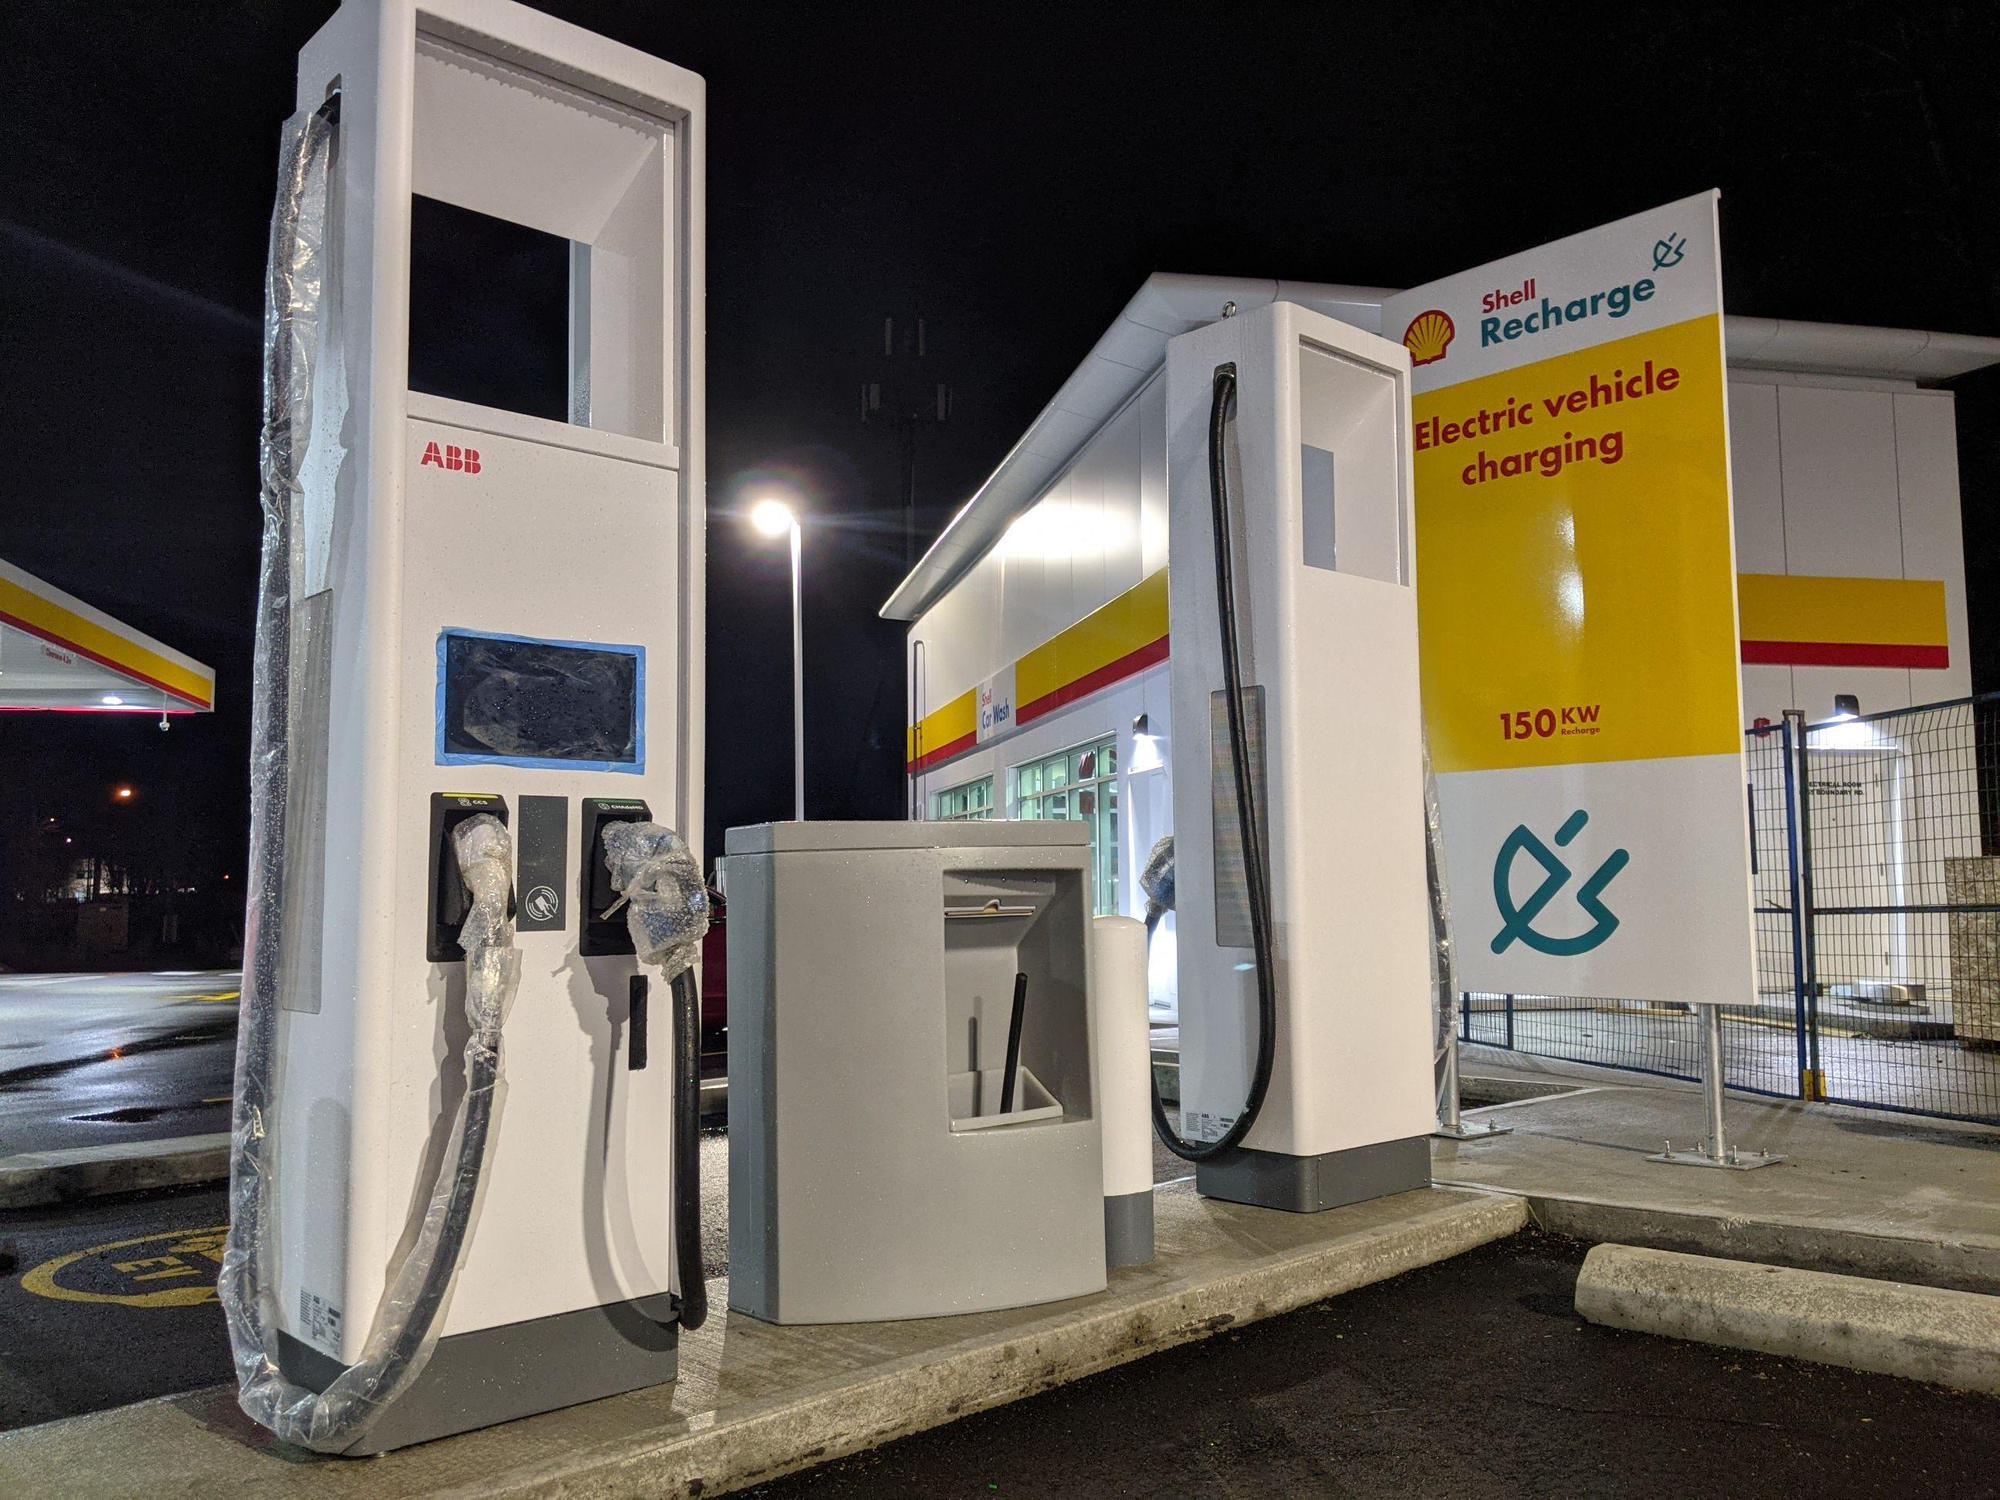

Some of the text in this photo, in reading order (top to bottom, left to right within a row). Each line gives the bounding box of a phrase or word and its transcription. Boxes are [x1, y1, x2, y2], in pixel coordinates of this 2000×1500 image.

[1480, 277, 1655, 348] Recharge
[1482, 278, 1536, 314] Shell
[1414, 360, 1681, 451] Electric vehicle
[420, 441, 482, 475] ABB
[1461, 430, 1624, 486] charging
[982, 697, 1010, 729] Car Wash
[1500, 704, 1601, 741] 150 KW
[1561, 726, 1600, 736] Recharge
